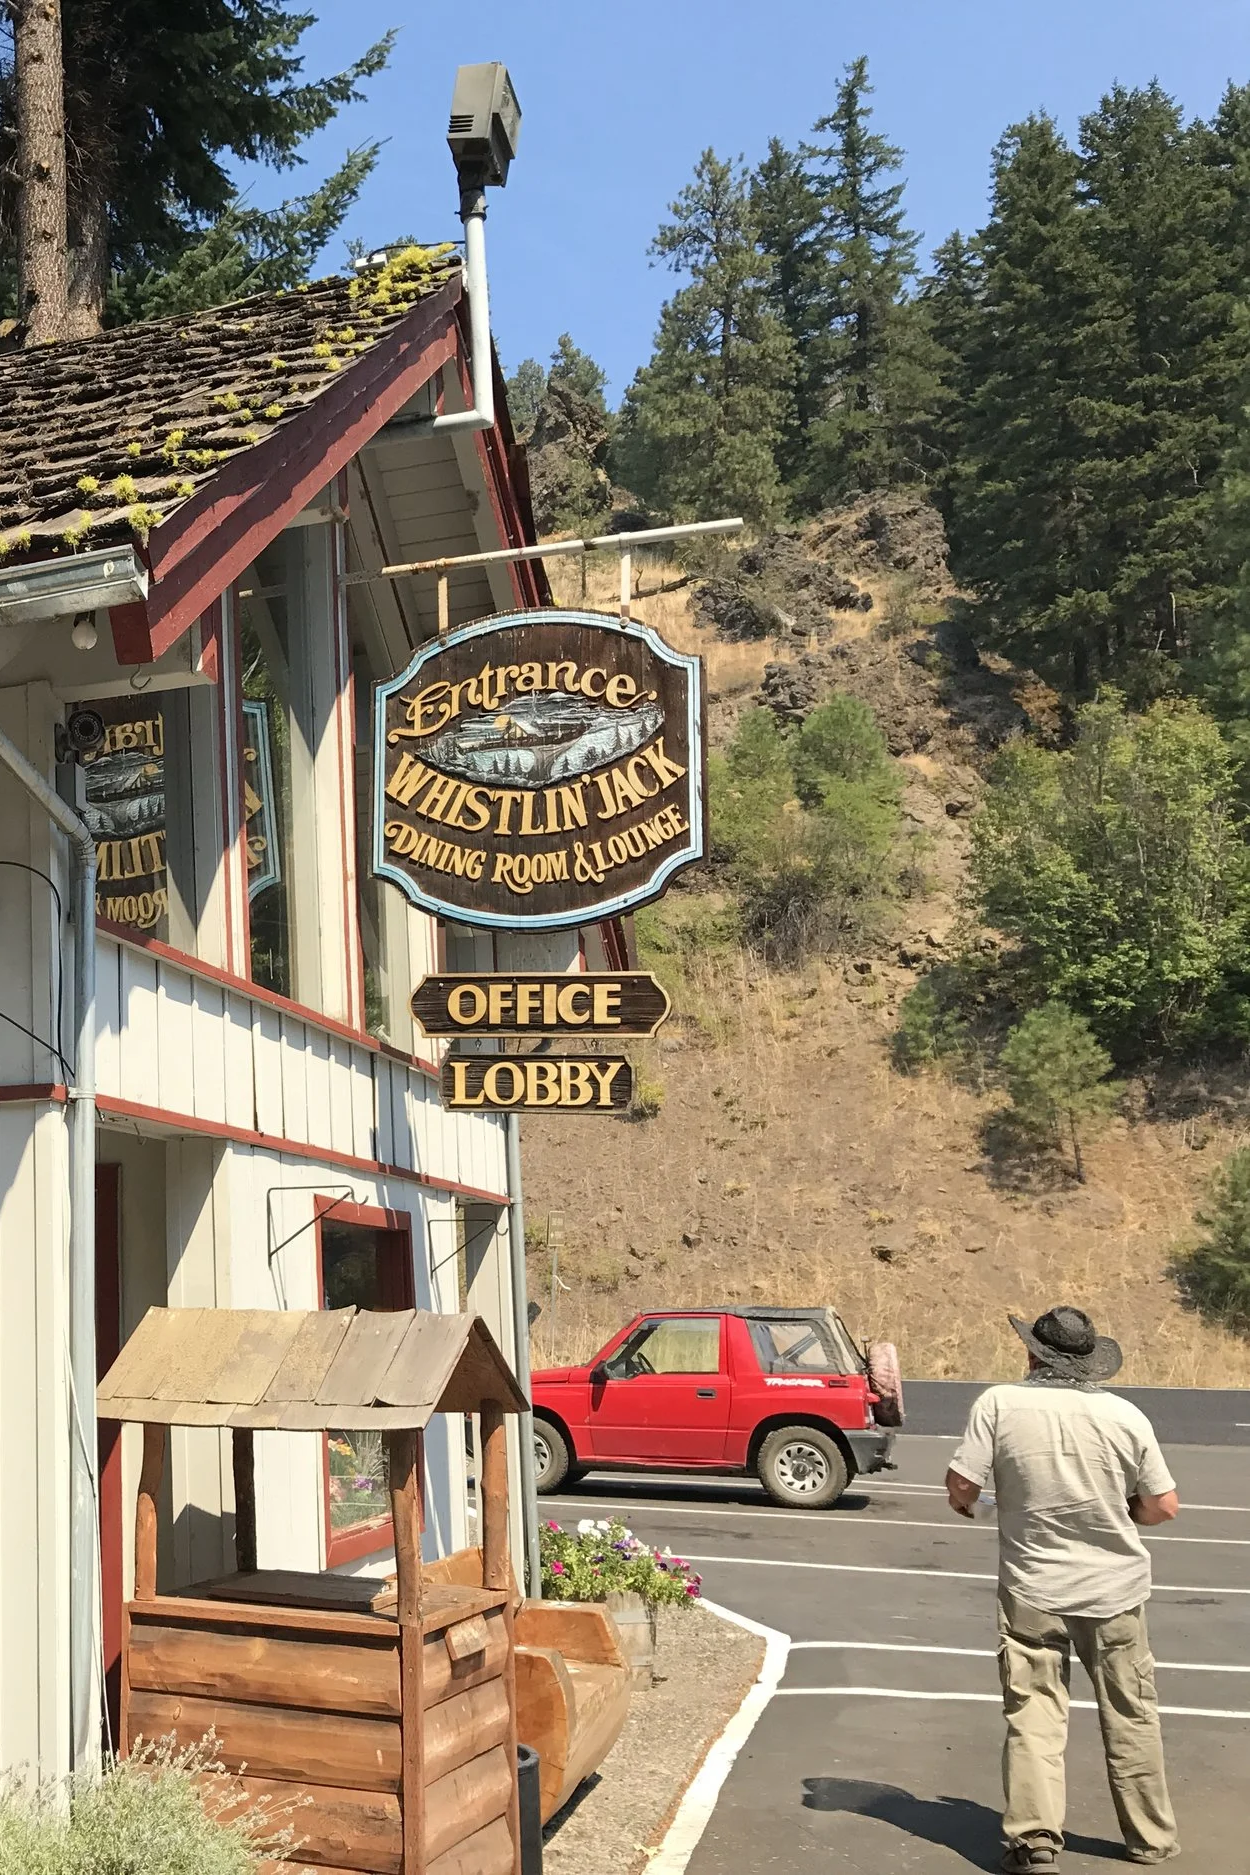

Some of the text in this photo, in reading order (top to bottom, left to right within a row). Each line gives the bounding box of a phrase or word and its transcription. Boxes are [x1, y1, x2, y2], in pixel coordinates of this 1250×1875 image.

[387, 661, 657, 744] Entrance
[597, 737, 687, 819] JACK
[384, 803, 690, 894] DINING ROOM & LOUNGE
[447, 983, 622, 1025] OFFICE
[450, 1061, 625, 1106] LOBBY
